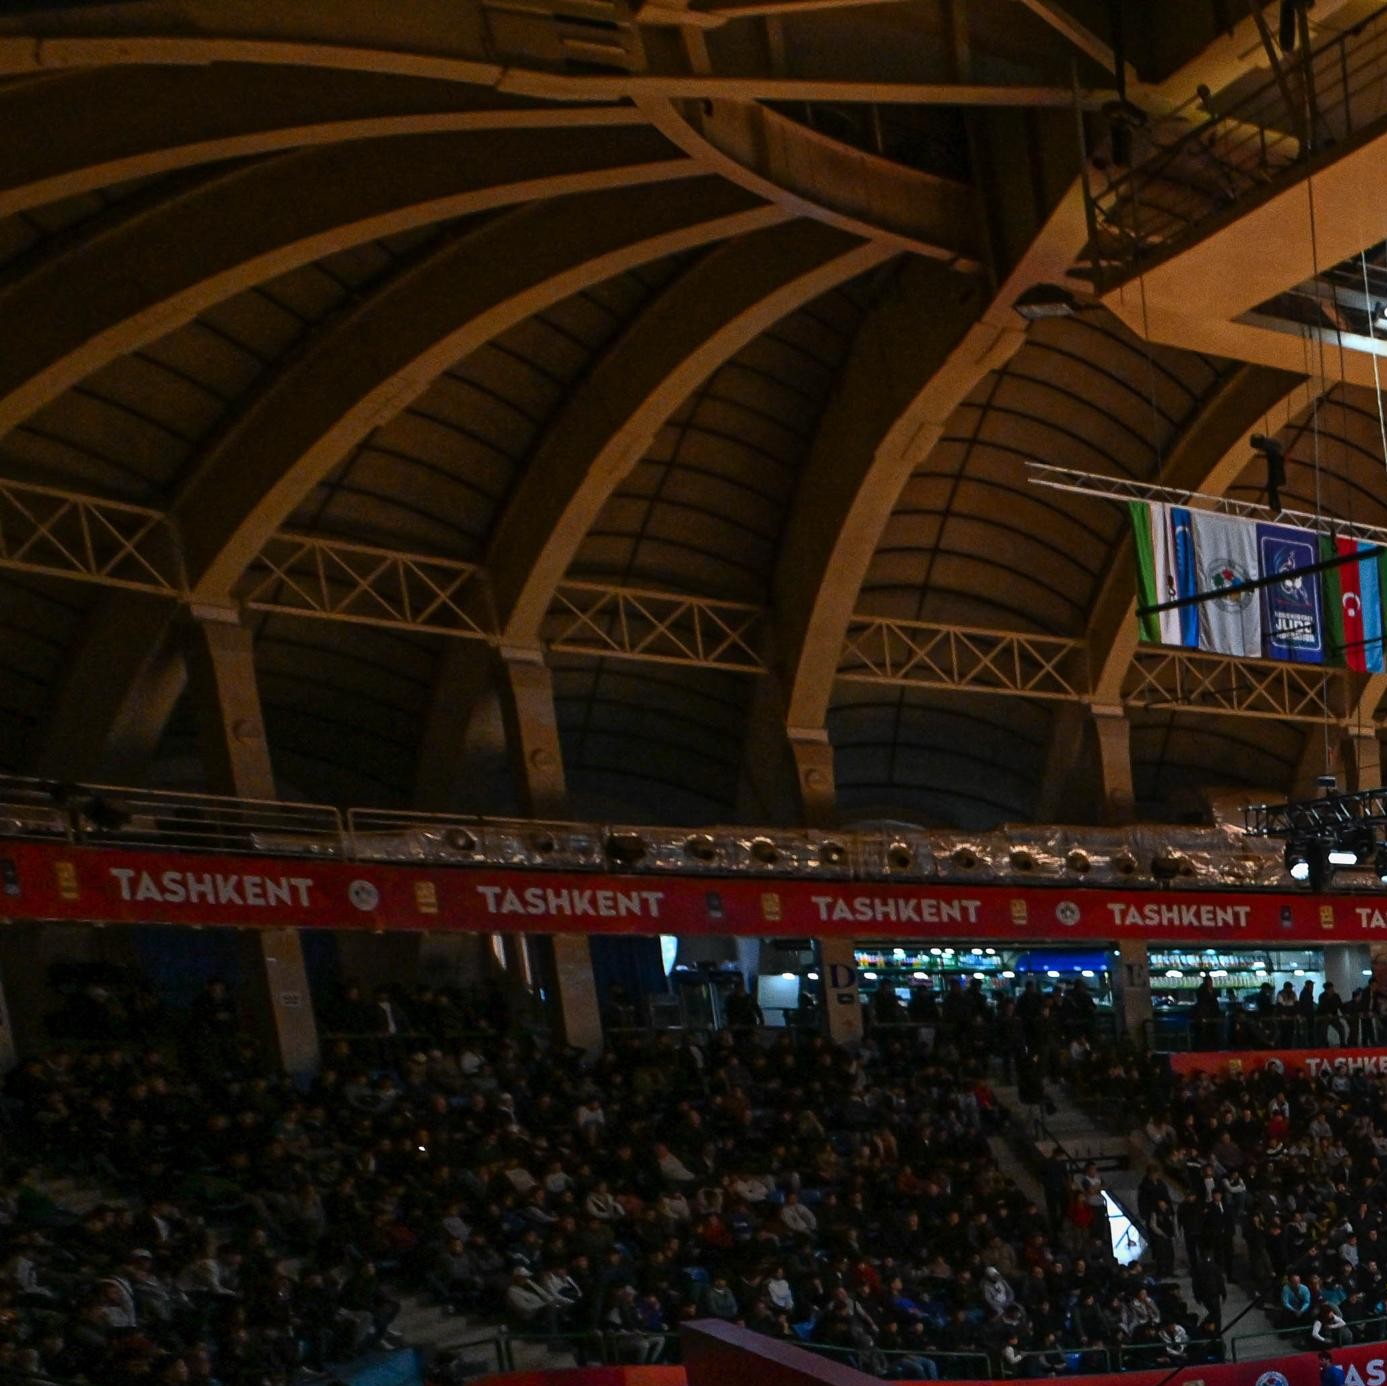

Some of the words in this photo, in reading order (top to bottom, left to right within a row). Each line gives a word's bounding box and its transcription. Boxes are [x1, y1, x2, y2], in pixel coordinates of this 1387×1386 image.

[109, 868, 314, 907] TASHKENT
[477, 885, 665, 917] TASHKENT
[811, 895, 981, 925] TASHKENT
[1107, 902, 1250, 928] TASHKENT
[831, 965, 856, 987] D
